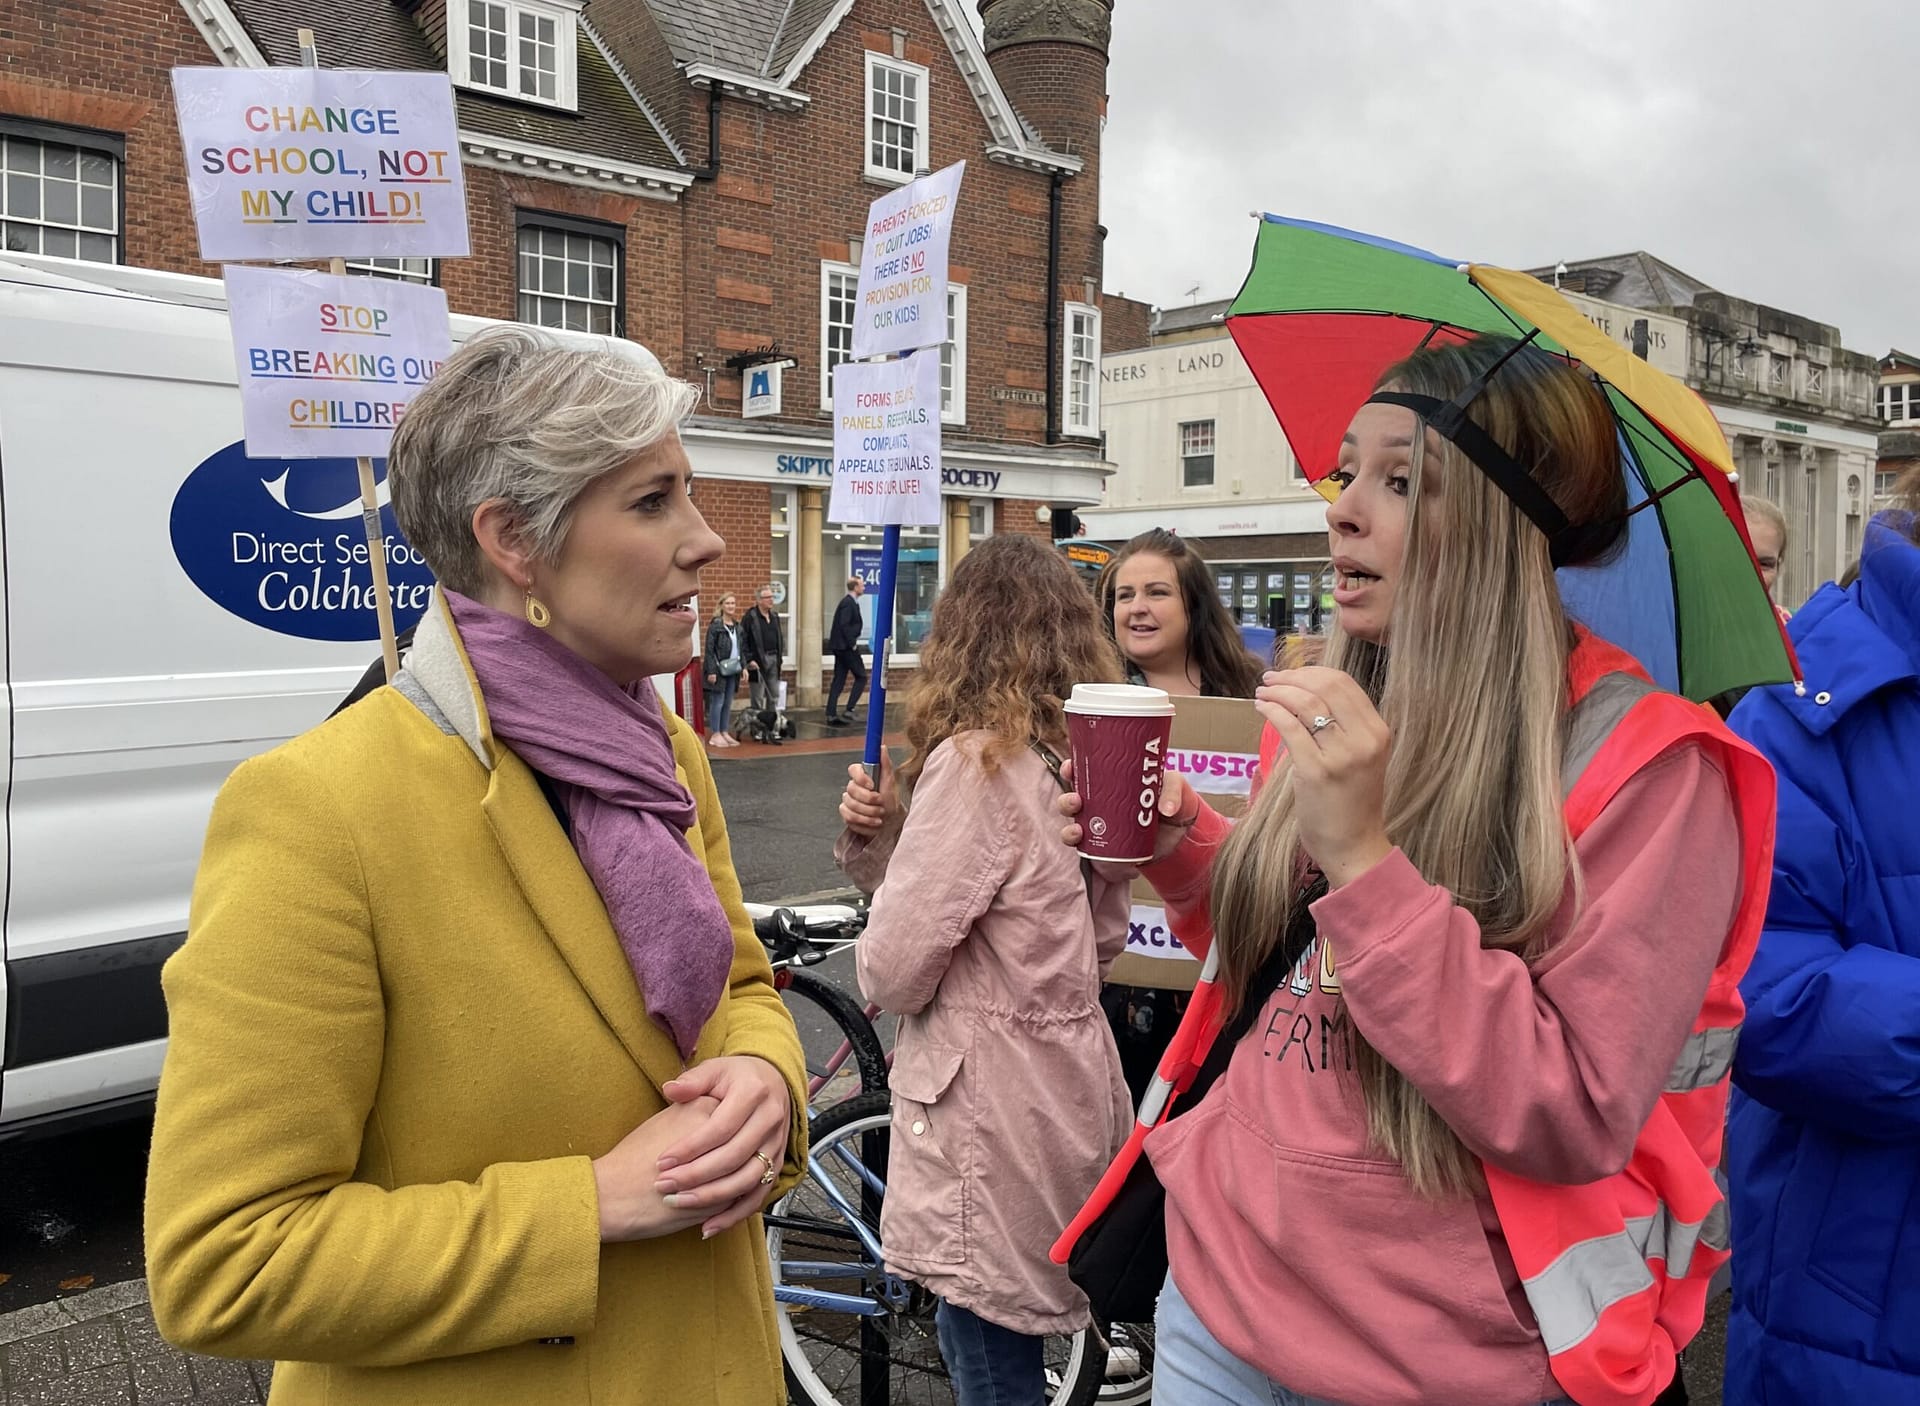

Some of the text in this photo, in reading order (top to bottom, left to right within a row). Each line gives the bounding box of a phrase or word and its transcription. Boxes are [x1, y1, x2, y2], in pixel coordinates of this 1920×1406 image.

[245, 106, 400, 135] CHANGE
[201, 147, 448, 179] SCHOOL, NOT
[241, 190, 422, 217] MY CHILD!
[872, 195, 947, 238] PARENTS FORCED
[875, 223, 933, 258] TO QUIT JOBS!
[874, 250, 925, 281] THERE IS NO
[865, 275, 932, 307] PROVISION FOR
[320, 303, 389, 330] STOP
[874, 304, 920, 329] OUR KIDS!
[1623, 326, 1666, 349] ANTS
[250, 348, 395, 378] BREAKING
[1101, 352, 1224, 382] NEERS LAND
[290, 399, 405, 424] CHILDRE
[857, 392, 893, 408] FORMS,
[842, 415, 885, 432] PANELS,
[777, 454, 833, 477] SKIPTO
[851, 481, 873, 494] THIS
[876, 481, 883, 494] IS
[900, 479, 921, 494] LIFE!
[232, 532, 426, 565] Direct Sefoo
[1166, 752, 1260, 779] CLUSIO
[1138, 736, 1161, 827] COSTA
